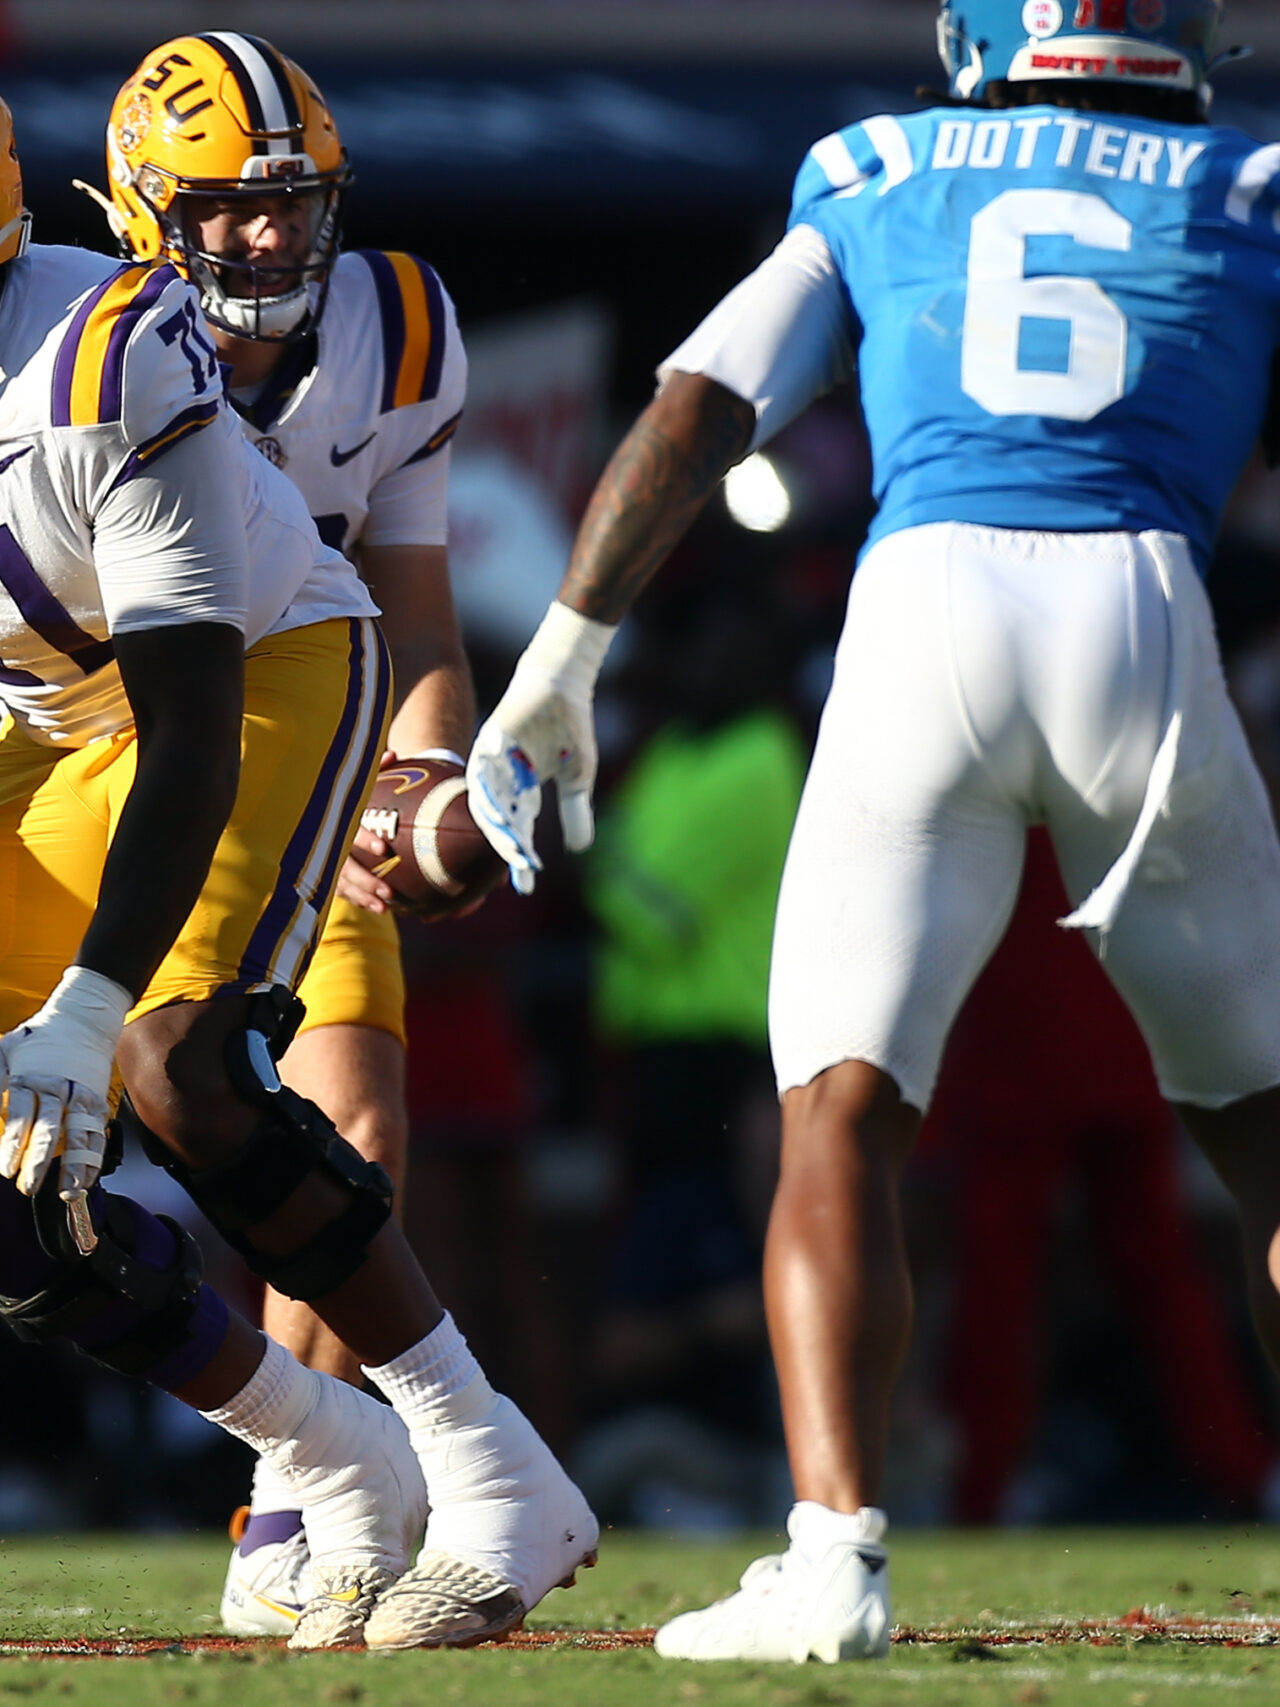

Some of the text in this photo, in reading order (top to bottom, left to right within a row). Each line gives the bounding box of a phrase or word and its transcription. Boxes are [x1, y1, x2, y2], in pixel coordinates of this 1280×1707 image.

[142, 54, 214, 123] SU
[931, 116, 1207, 188] DOTTERY
[155, 296, 218, 396] 71
[960, 188, 1132, 422] 6
